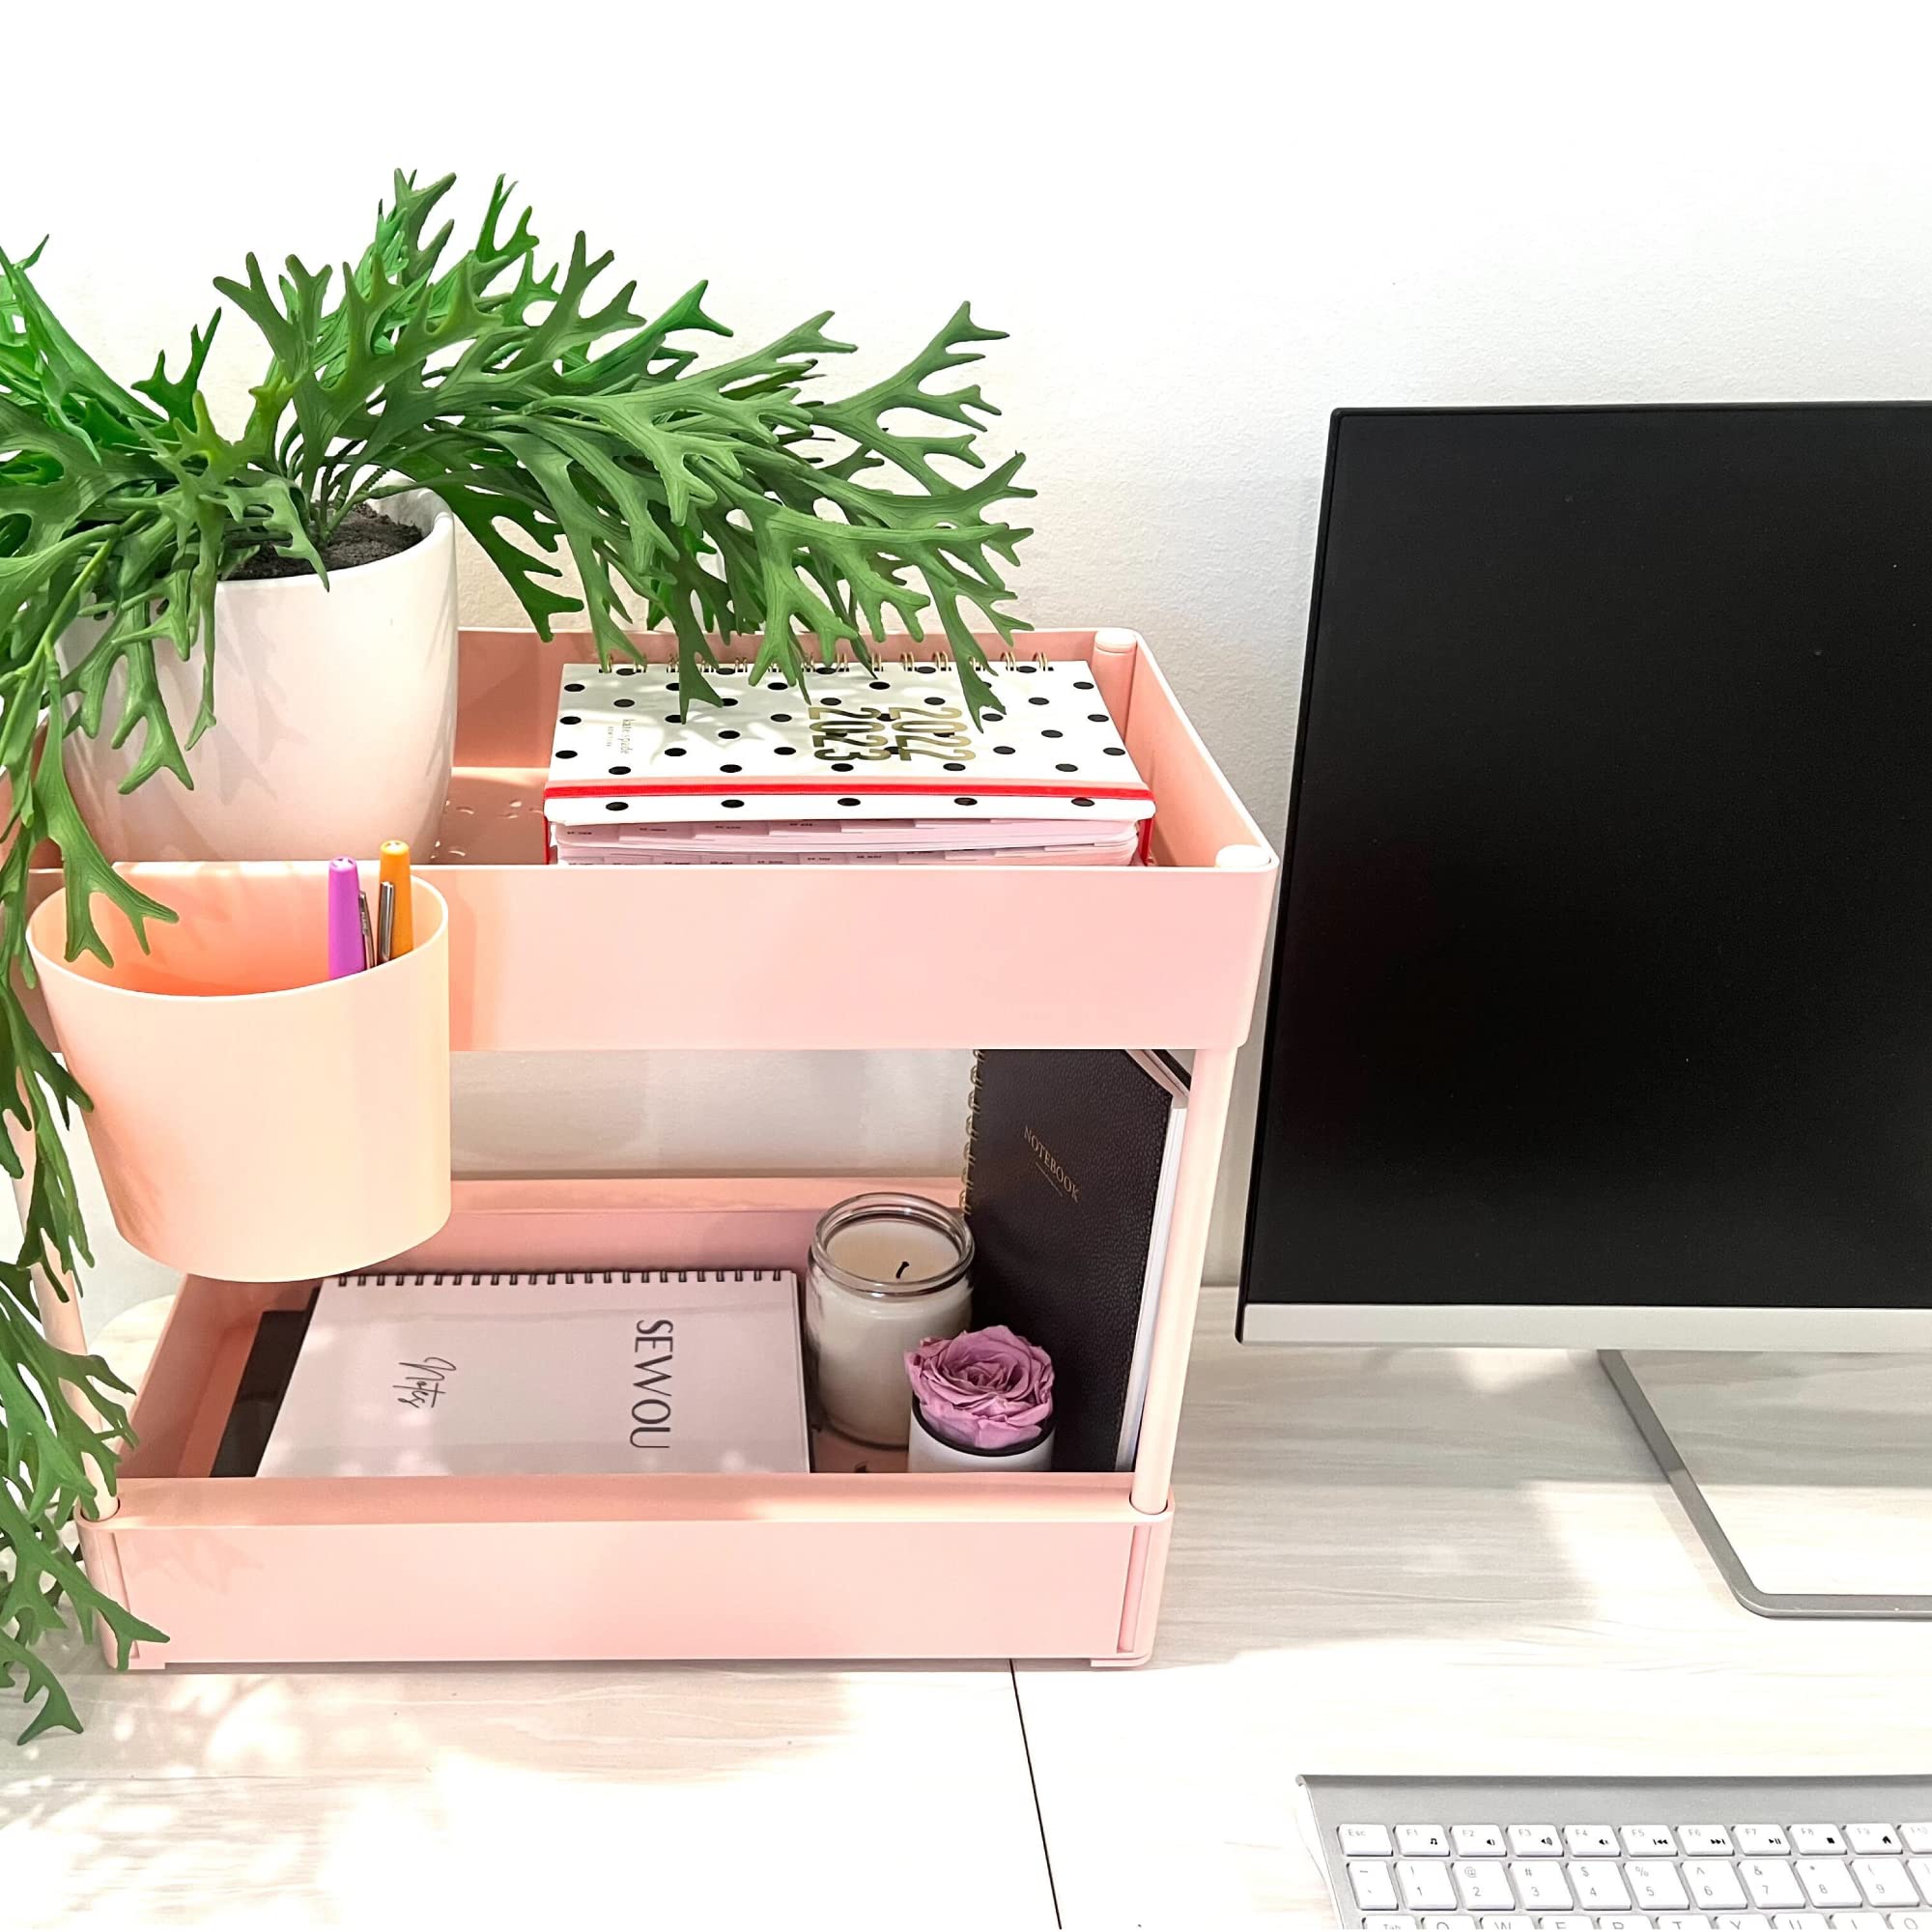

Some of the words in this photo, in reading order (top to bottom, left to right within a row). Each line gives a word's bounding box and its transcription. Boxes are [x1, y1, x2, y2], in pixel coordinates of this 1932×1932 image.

[622, 719, 636, 732] kate
[809, 707, 891, 761] 2023
[889, 707, 976, 761] 2022
[618, 734, 634, 754] spade
[1024, 1125, 1080, 1204] NOTEBOOK
[392, 1356, 457, 1408] Notes
[630, 1320, 673, 1449] SEWOU
[1463, 1829, 1475, 1837] F2
[1632, 1829, 1645, 1837] F5
[1745, 1828, 1757, 1836] F7
[1463, 1865, 1478, 1879] @
[1523, 1866, 1534, 1877] #
[1634, 1865, 1650, 1877] %
[1416, 1886, 1423, 1896] 1
[1472, 1886, 1482, 1897] 2
[1530, 1886, 1541, 1897] 3
[1589, 1887, 1598, 1897] 4
[1645, 1886, 1656, 1897] 5
[1703, 1886, 1714, 1896] 6
[1761, 1885, 1770, 1895] 7
[1818, 1884, 1829, 1894] 8
[1875, 1884, 1886, 1894] 9
